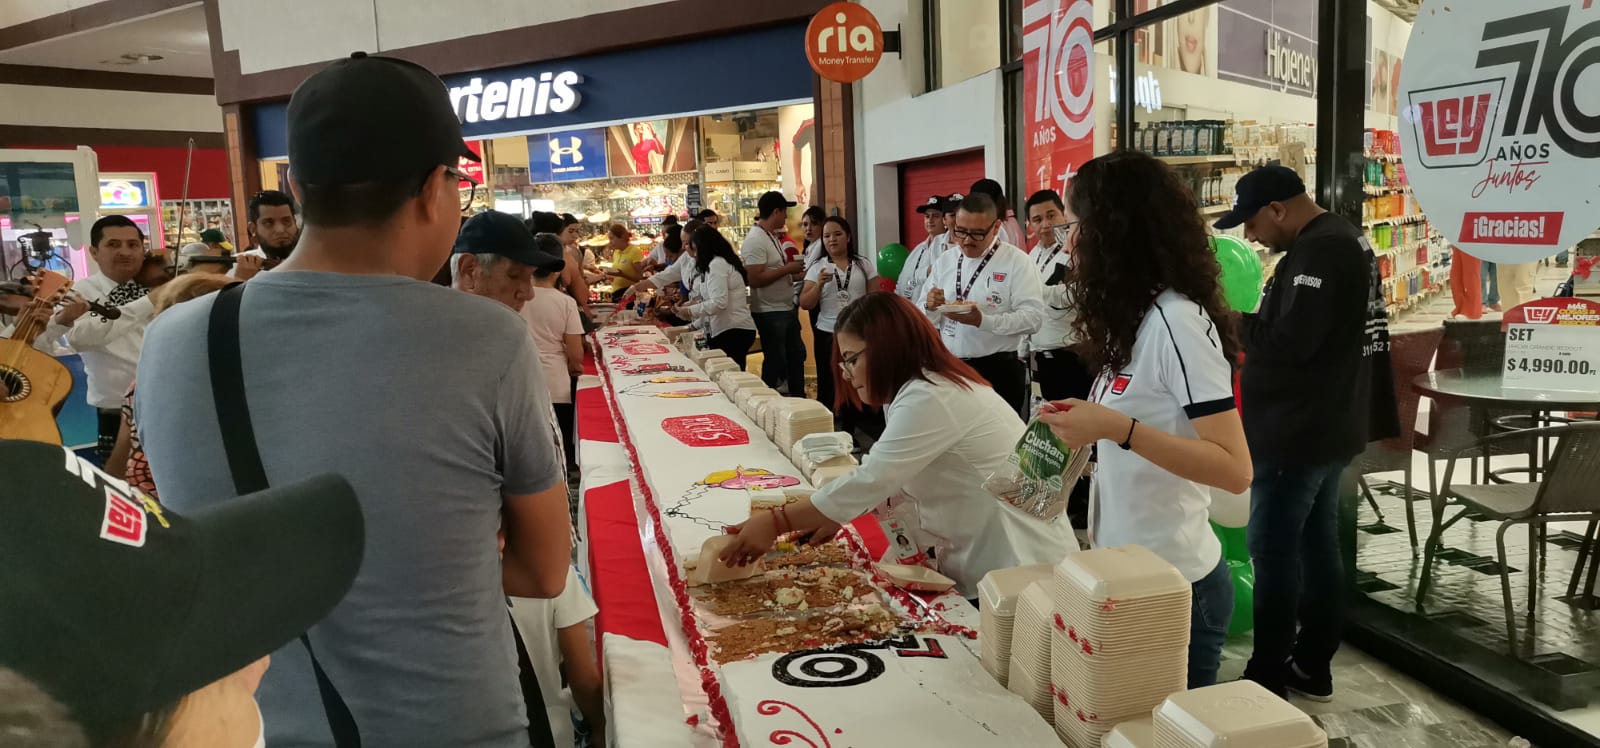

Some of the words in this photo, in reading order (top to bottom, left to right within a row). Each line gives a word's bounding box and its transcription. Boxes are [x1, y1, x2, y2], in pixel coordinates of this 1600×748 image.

[818, 12, 875, 53] ria
[818, 56, 845, 66] Money
[845, 55, 874, 64] Transfer
[1267, 29, 1311, 94] Higiene
[1033, 124, 1057, 148] AÑOS
[1418, 93, 1491, 157] Ley
[1496, 141, 1550, 161] AÑOS
[1471, 157, 1549, 199] Juntos
[1473, 216, 1545, 238] ¡Gracias!
[1293, 274, 1322, 288] SERVISOR
[1509, 328, 1535, 341] SET
[1507, 358, 1516, 371] $
[1518, 358, 1590, 375] 4,990.00
[1025, 431, 1065, 463] Cuchara
[106, 492, 142, 542] Ley
